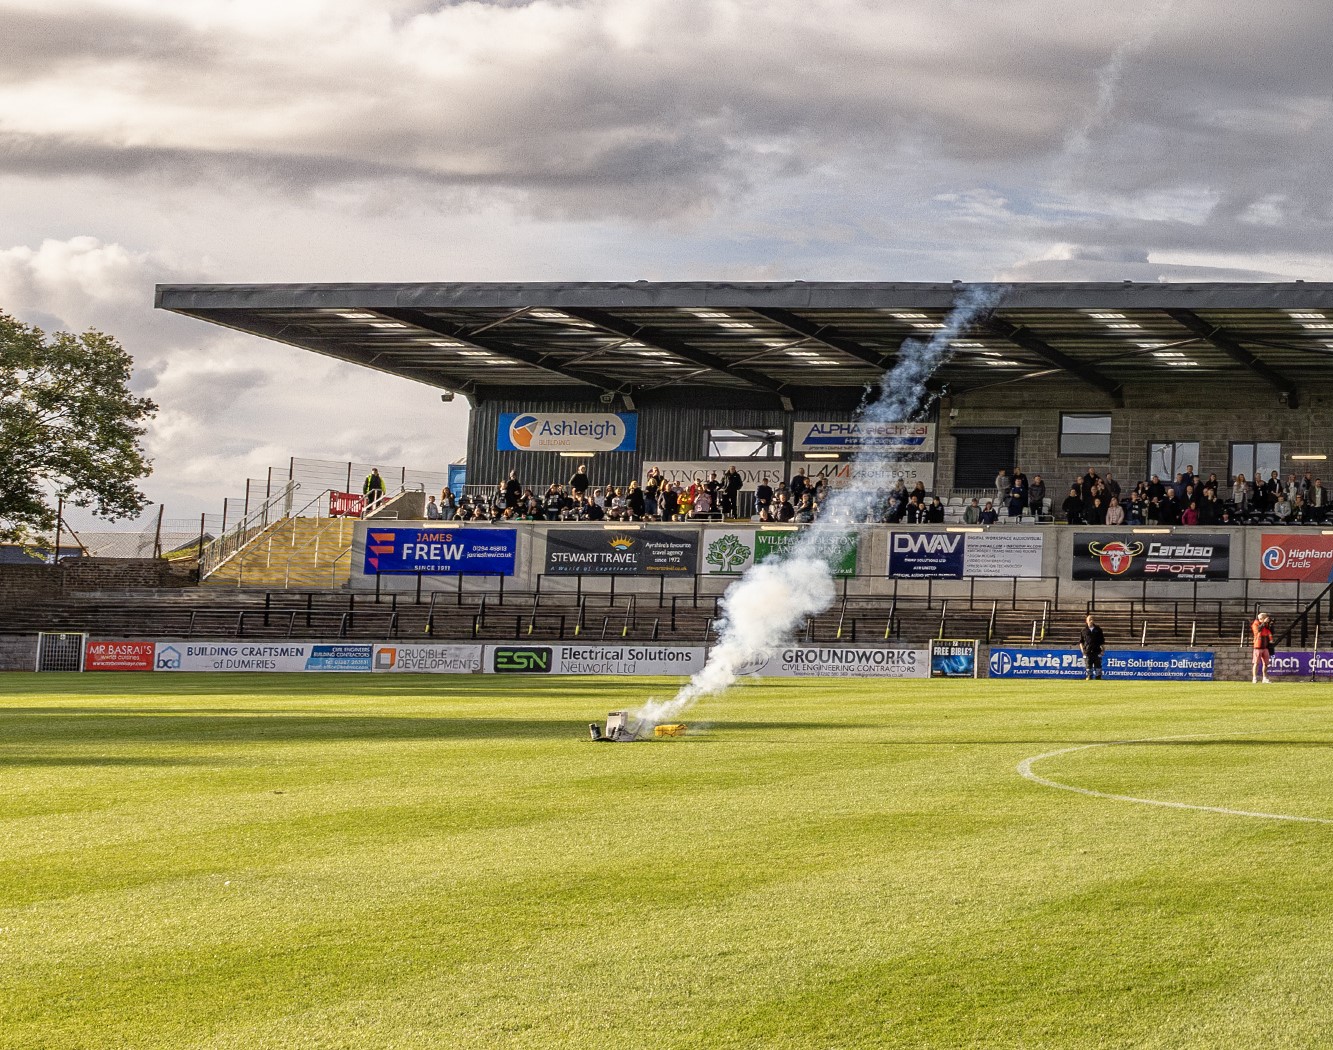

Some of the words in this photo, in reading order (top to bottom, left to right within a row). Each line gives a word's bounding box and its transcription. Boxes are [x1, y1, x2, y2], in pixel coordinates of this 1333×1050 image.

[539, 420, 616, 440] Ashleigh
[807, 424, 861, 437] ALPHA
[866, 425, 927, 435] electrical
[663, 469, 717, 482] LYNCH
[853, 470, 917, 478] ARCHITECTS
[417, 533, 453, 542] JAMES
[894, 534, 961, 553] DWAV
[402, 544, 464, 560] FREW
[1147, 543, 1213, 556] Carabao
[1289, 549, 1333, 559] Highland
[551, 553, 597, 563] STEWART
[599, 553, 637, 563] TRAVEL
[1144, 564, 1209, 573] SPORT
[1286, 560, 1310, 568] Fuels
[89, 646, 106, 654] MR
[109, 646, 152, 654] BASRAI'S
[187, 647, 238, 656] BUILDING
[242, 647, 304, 656] CRAFTSMEN
[398, 649, 447, 659] CRUCIBLE
[561, 648, 623, 661] Electrical
[628, 648, 692, 662] Solutions
[933, 647, 949, 655] FREE
[951, 647, 973, 656] BIBLE?
[497, 651, 547, 669] ESN
[782, 650, 916, 665] GROUNDWORKS
[1013, 654, 1059, 667] Jarvie
[1107, 659, 1126, 667] Hire
[1128, 659, 1169, 668] Solutions
[1171, 660, 1212, 668] Delivered
[1267, 655, 1299, 668] cinch
[213, 659, 223, 668] of
[226, 659, 275, 669] DUMFRIES
[398, 659, 479, 670] DEVELOPMENTS
[561, 661, 613, 673] Network
[617, 662, 636, 673] Ltd
[803, 664, 854, 672] ENGINEERING
